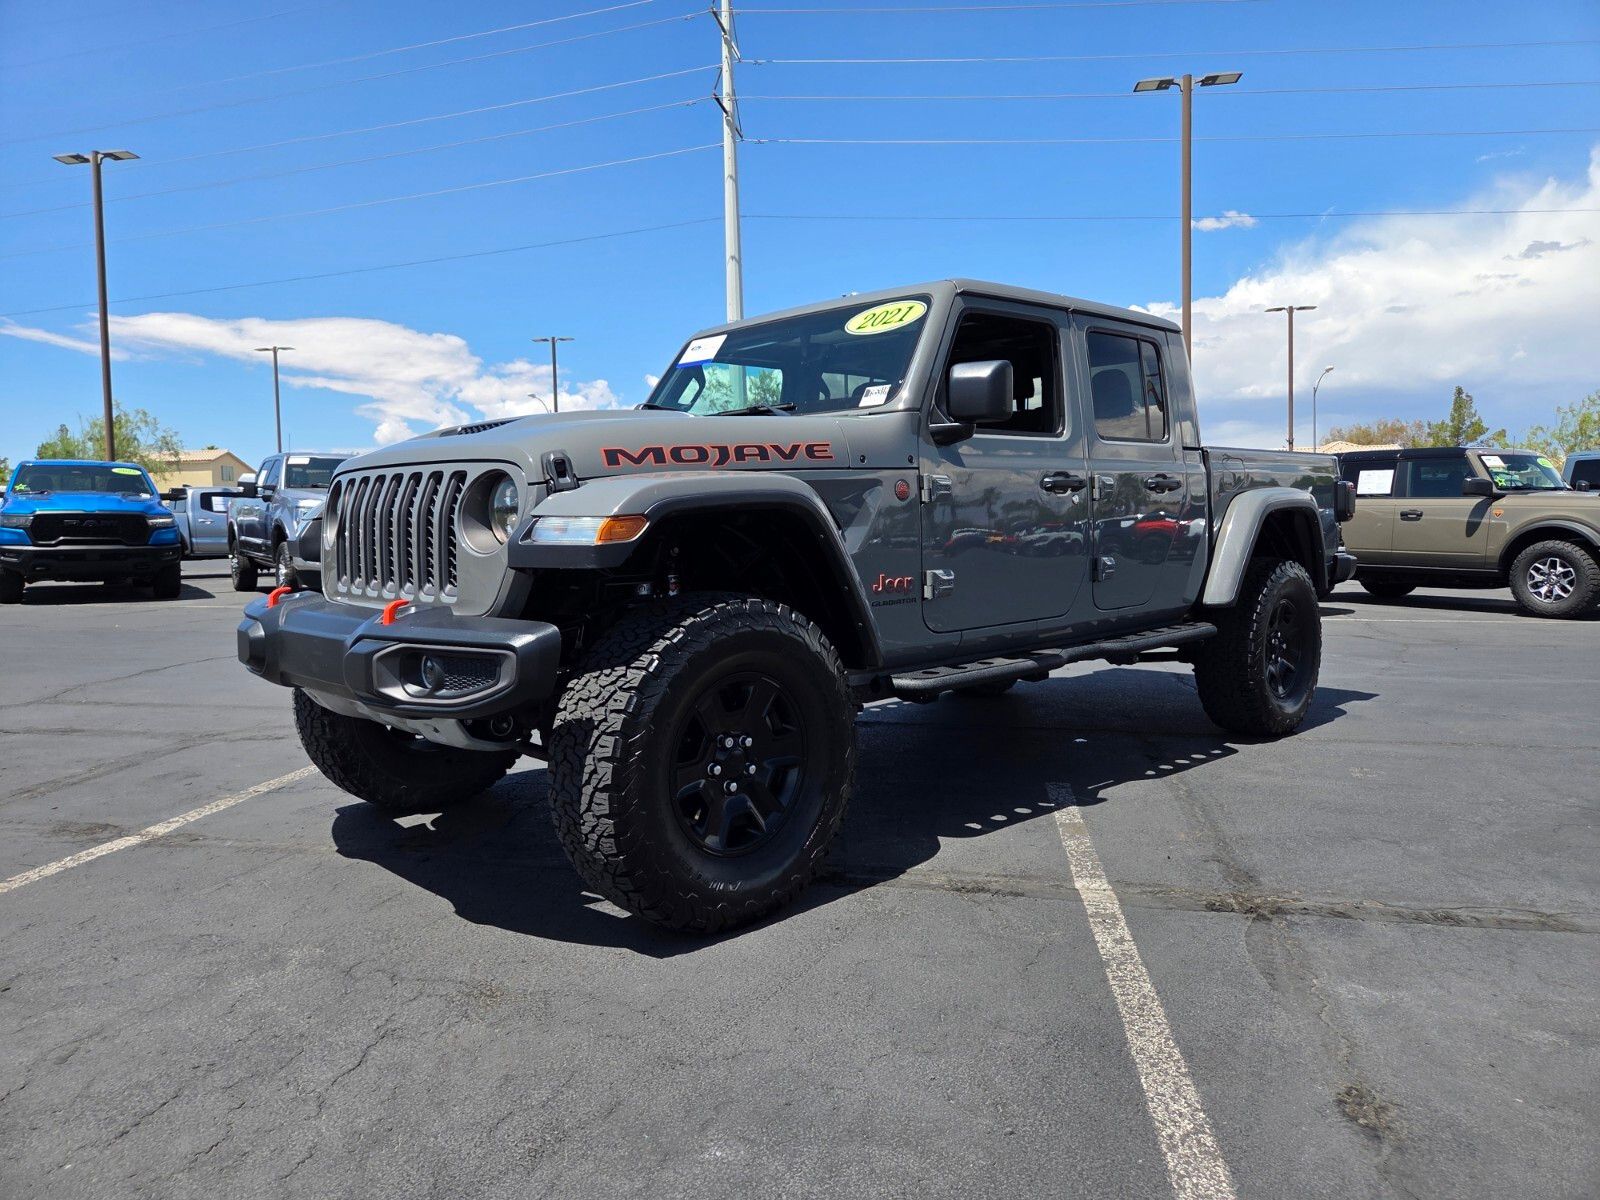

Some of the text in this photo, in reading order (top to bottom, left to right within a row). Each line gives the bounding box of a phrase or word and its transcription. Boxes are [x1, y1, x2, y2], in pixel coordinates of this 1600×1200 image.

[856, 305, 915, 330] 2021
[602, 443, 834, 467] MOJAVE
[872, 573, 914, 592] Jeep
[871, 597, 917, 607] GLADIATOR
